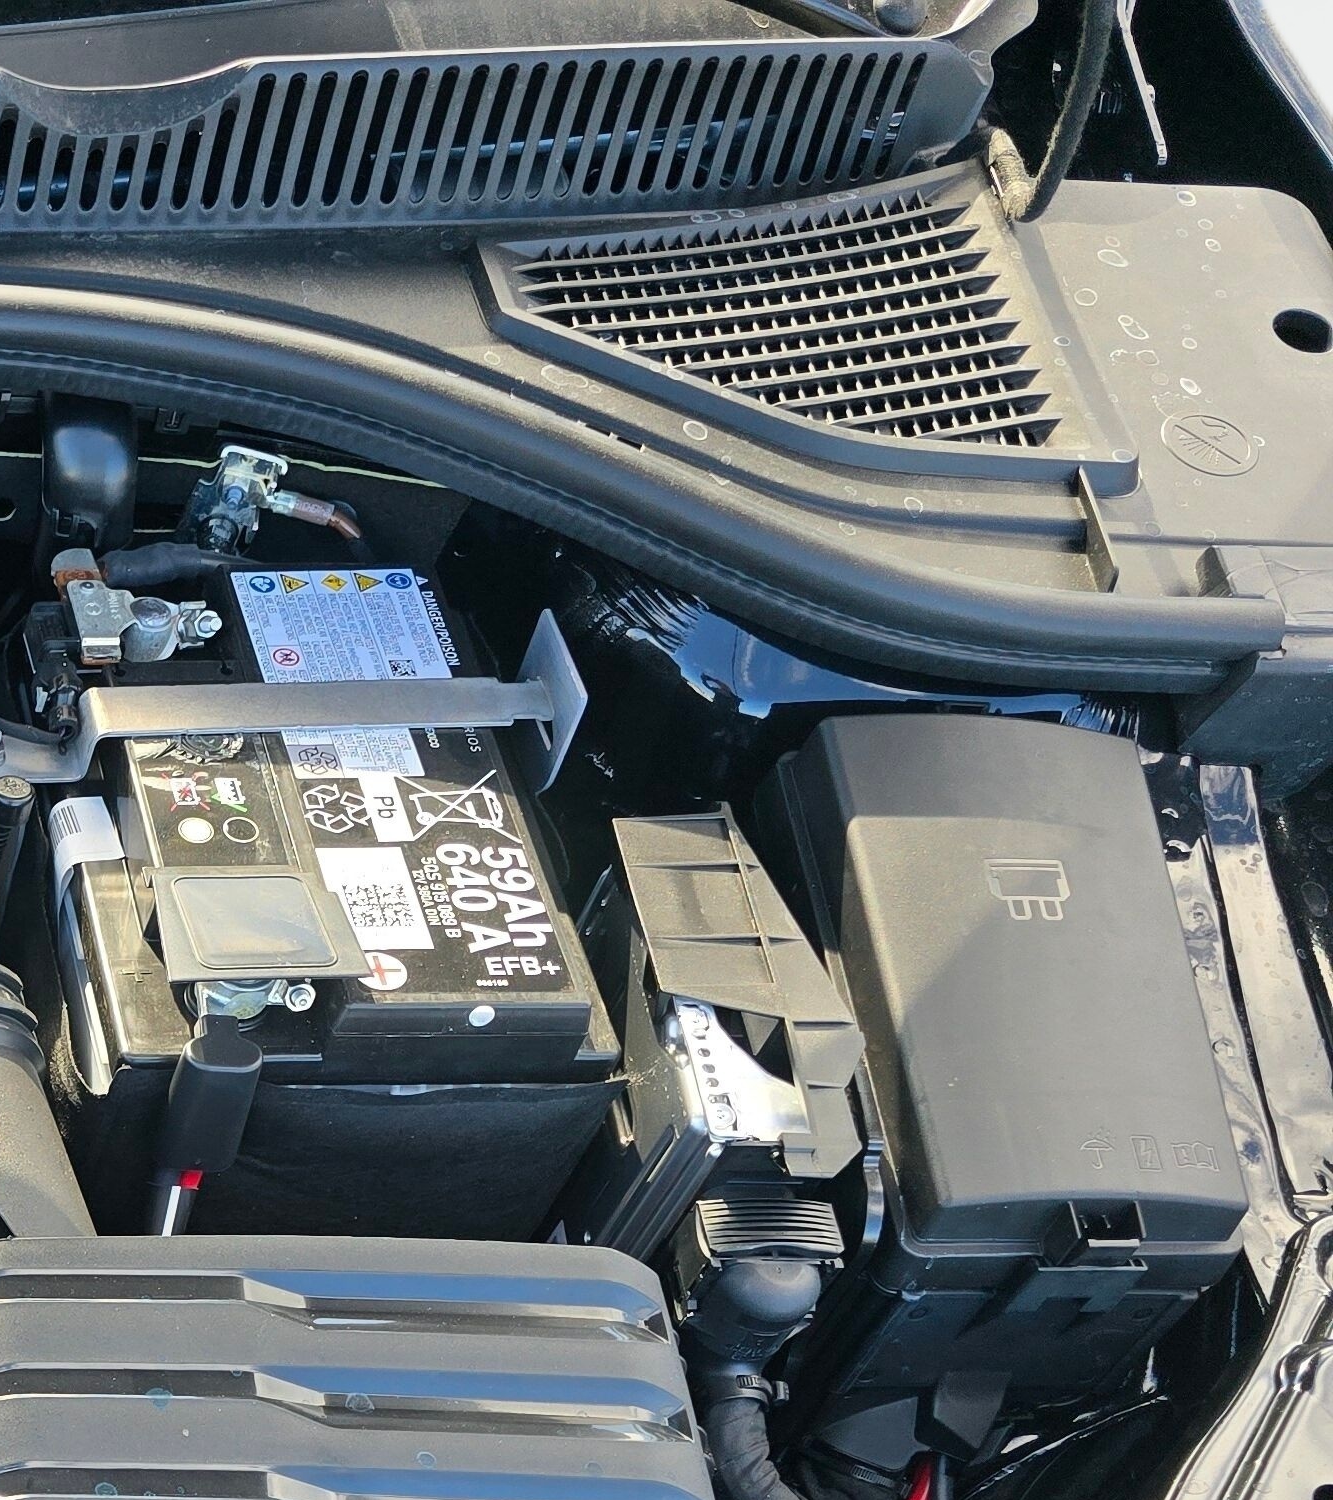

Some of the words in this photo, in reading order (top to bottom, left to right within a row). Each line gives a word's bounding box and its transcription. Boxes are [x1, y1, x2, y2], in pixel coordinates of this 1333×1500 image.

[421, 591, 461, 666] DANGER/POISON
[373, 796, 397, 818] Pb
[435, 843, 498, 912] 640
[482, 846, 554, 947] 59Ah
[430, 883, 449, 903] 915
[444, 928, 462, 938] B
[461, 922, 511, 954] A
[484, 956, 562, 976] EFB+
